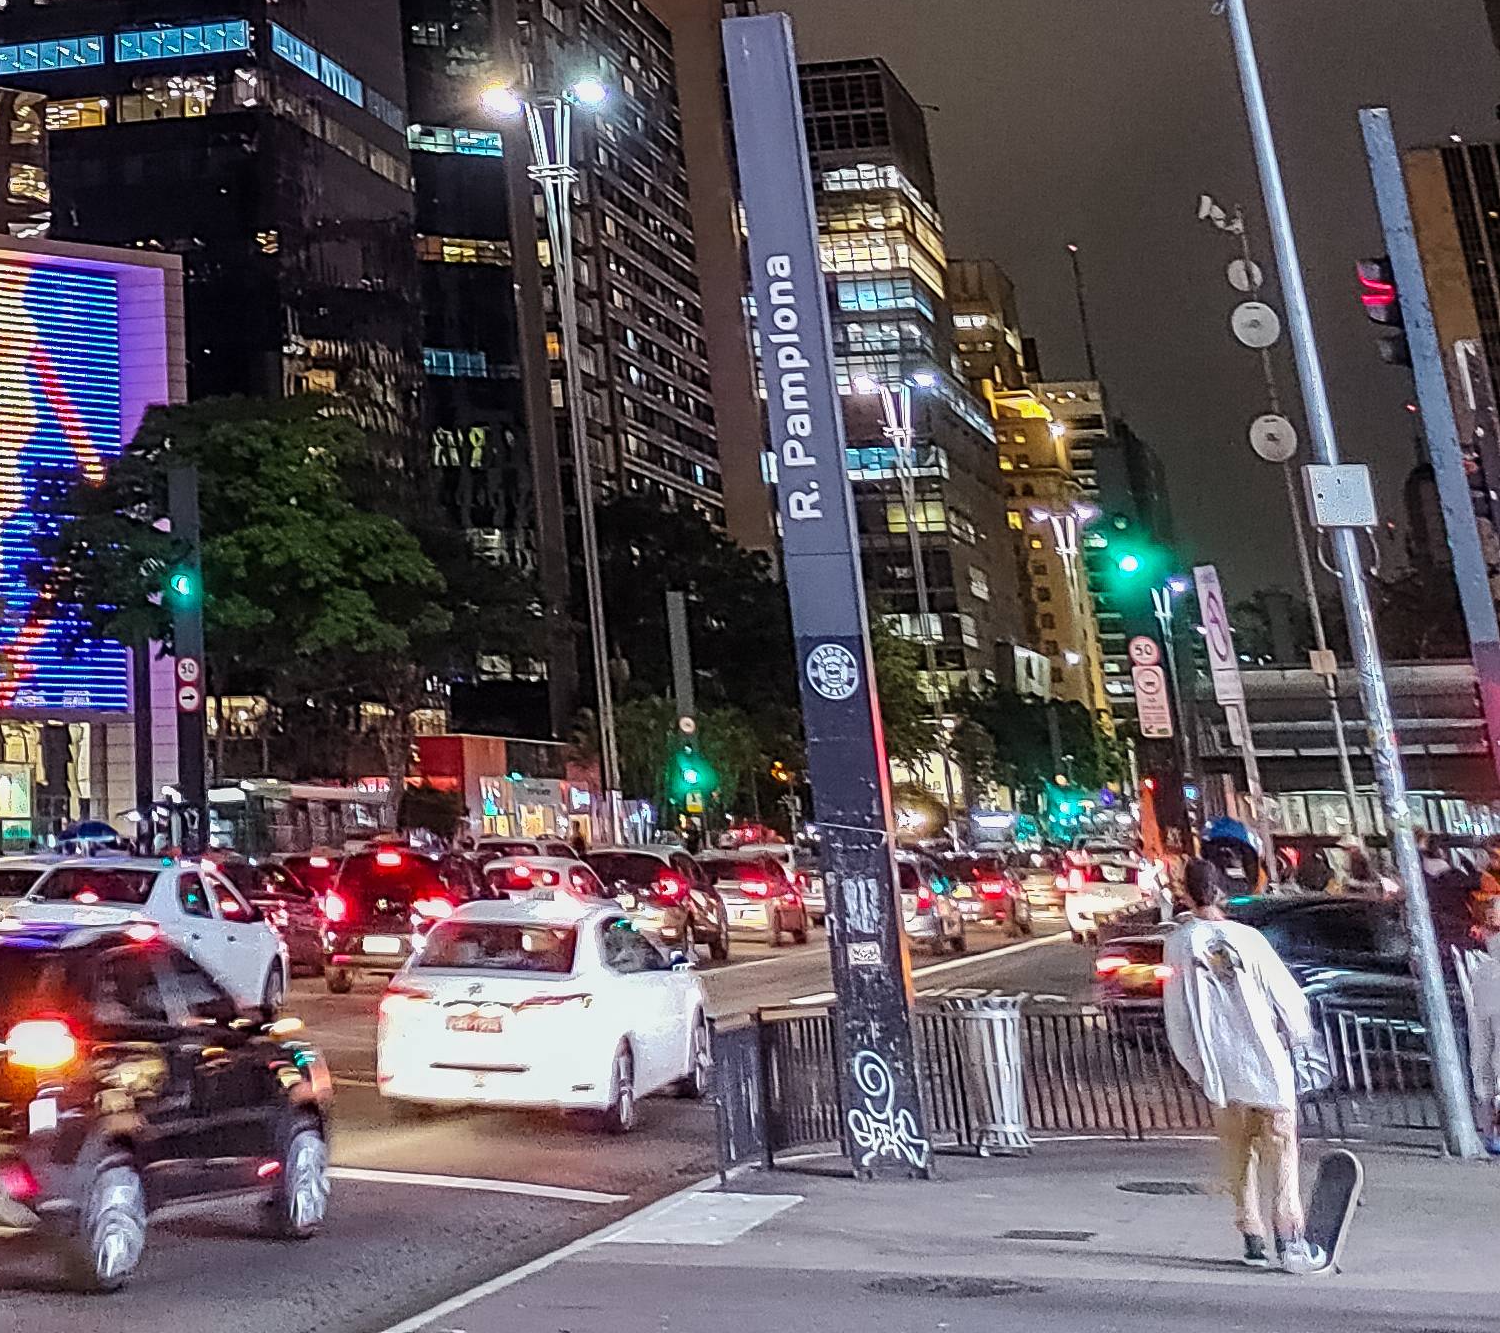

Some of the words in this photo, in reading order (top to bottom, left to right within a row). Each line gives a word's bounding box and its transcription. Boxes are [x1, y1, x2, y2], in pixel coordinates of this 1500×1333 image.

[766, 255, 816, 466] Pamplona
[788, 481, 823, 520] R.
[1134, 643, 1152, 655] 50
